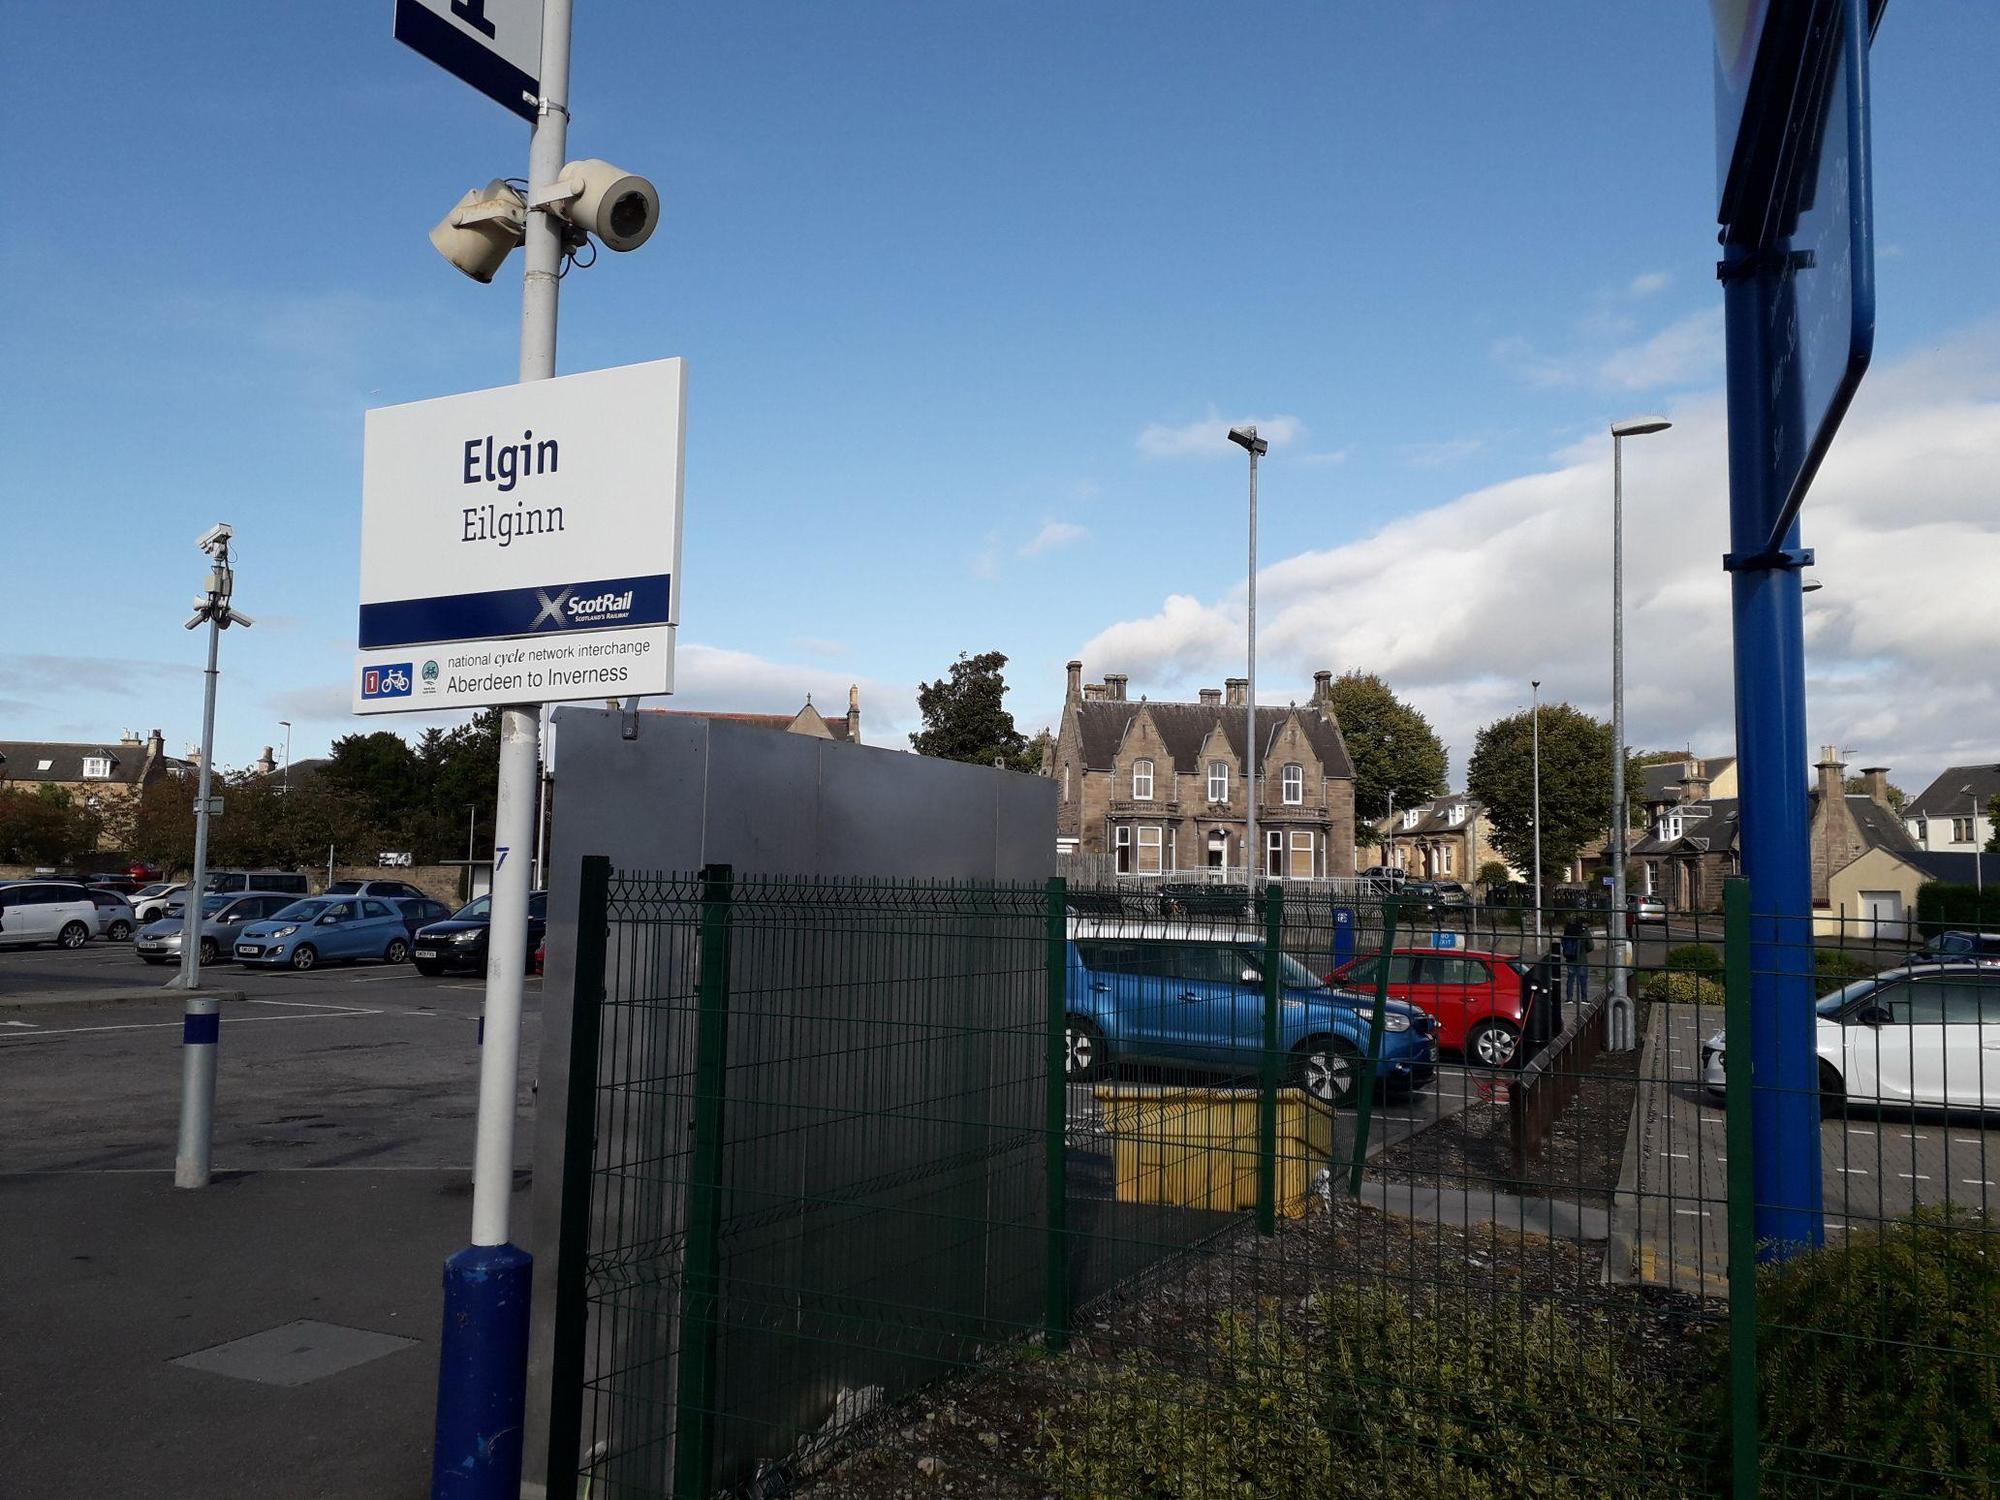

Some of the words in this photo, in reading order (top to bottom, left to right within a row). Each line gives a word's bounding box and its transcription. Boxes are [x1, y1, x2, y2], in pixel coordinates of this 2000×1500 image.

[463, 429, 559, 492] Elgin
[461, 501, 565, 547] Eilginn
[567, 591, 633, 615] ScotRail
[447, 652, 492, 668] national
[494, 648, 526, 668] cycle
[528, 645, 576, 661] network
[578, 641, 651, 656] interchange
[446, 673, 523, 694] Aberdeen
[528, 671, 543, 687] to
[548, 666, 629, 686] Inverness
[495, 847, 510, 872] 7
